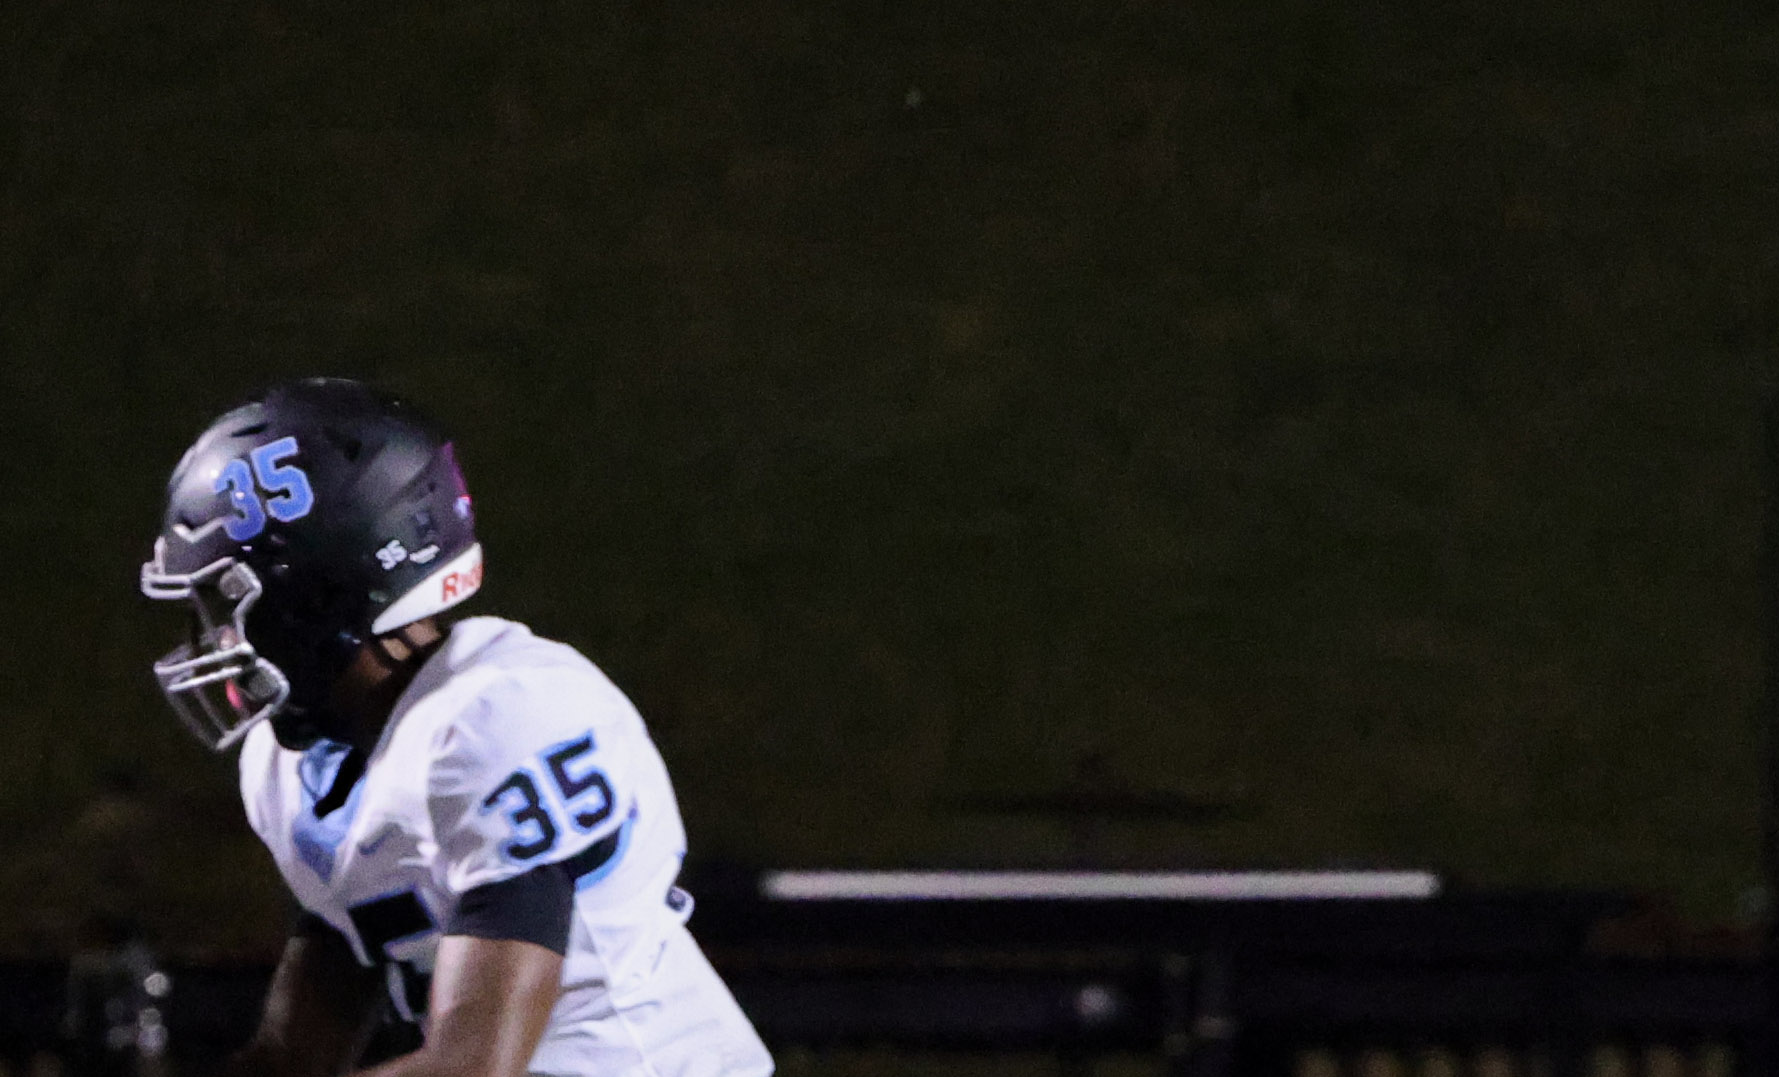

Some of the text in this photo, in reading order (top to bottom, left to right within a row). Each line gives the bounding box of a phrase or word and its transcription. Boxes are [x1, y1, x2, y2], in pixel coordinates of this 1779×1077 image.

[213, 436, 314, 541] 35
[375, 540, 408, 570] 35
[480, 728, 617, 863] 35
